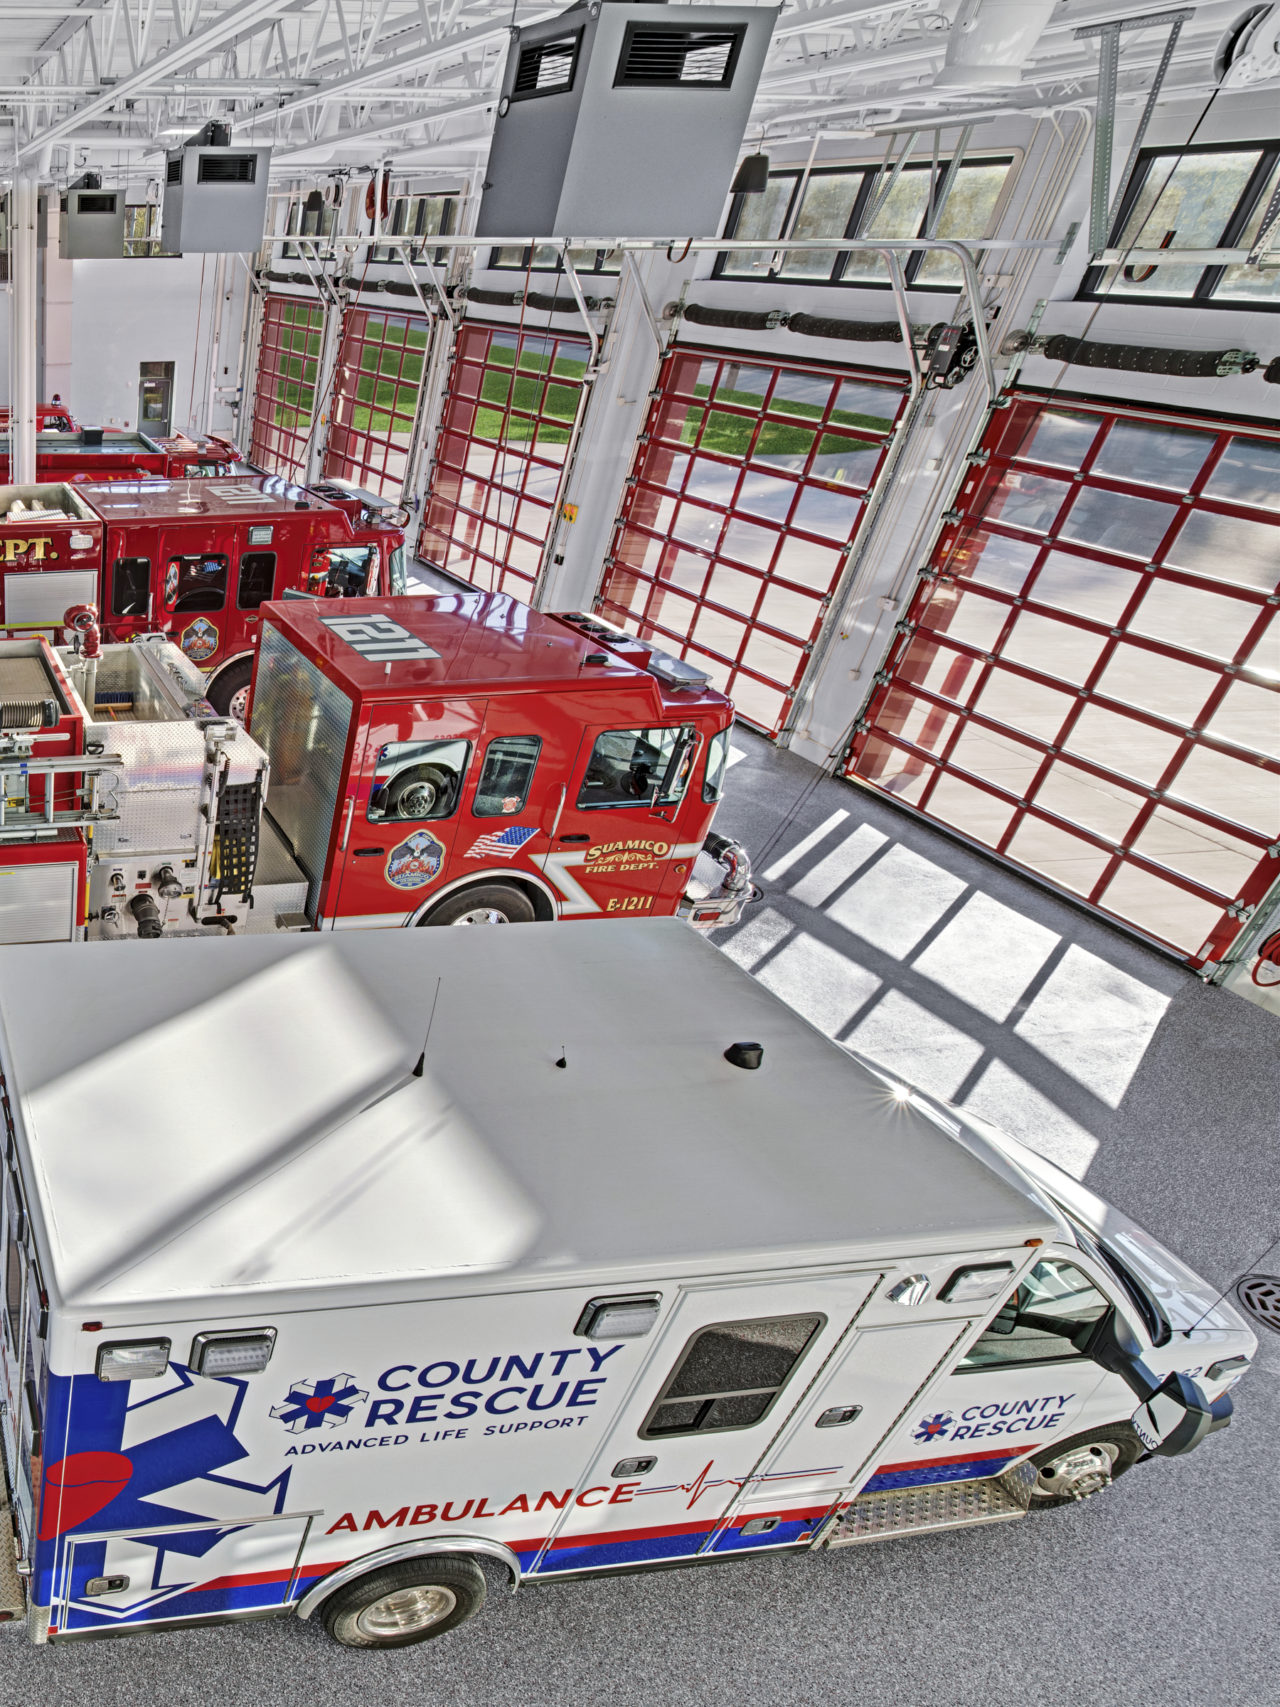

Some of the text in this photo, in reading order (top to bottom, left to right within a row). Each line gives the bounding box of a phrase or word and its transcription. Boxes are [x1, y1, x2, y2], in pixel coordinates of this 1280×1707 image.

[204, 484, 277, 504] 1211
[318, 614, 442, 662] 1211
[586, 839, 669, 861] SUAMICO
[585, 862, 660, 874] FIRE DEPT.
[606, 895, 655, 912] E-1211
[377, 1344, 625, 1392] COUNTY
[364, 1378, 608, 1428] RESCUE
[961, 1393, 1077, 1421] COUNTY
[284, 1415, 590, 1457] ADVANCED LIFE SUPPORT
[949, 1412, 1065, 1442] RESCUE
[324, 1482, 642, 1535] AMBULANCE
